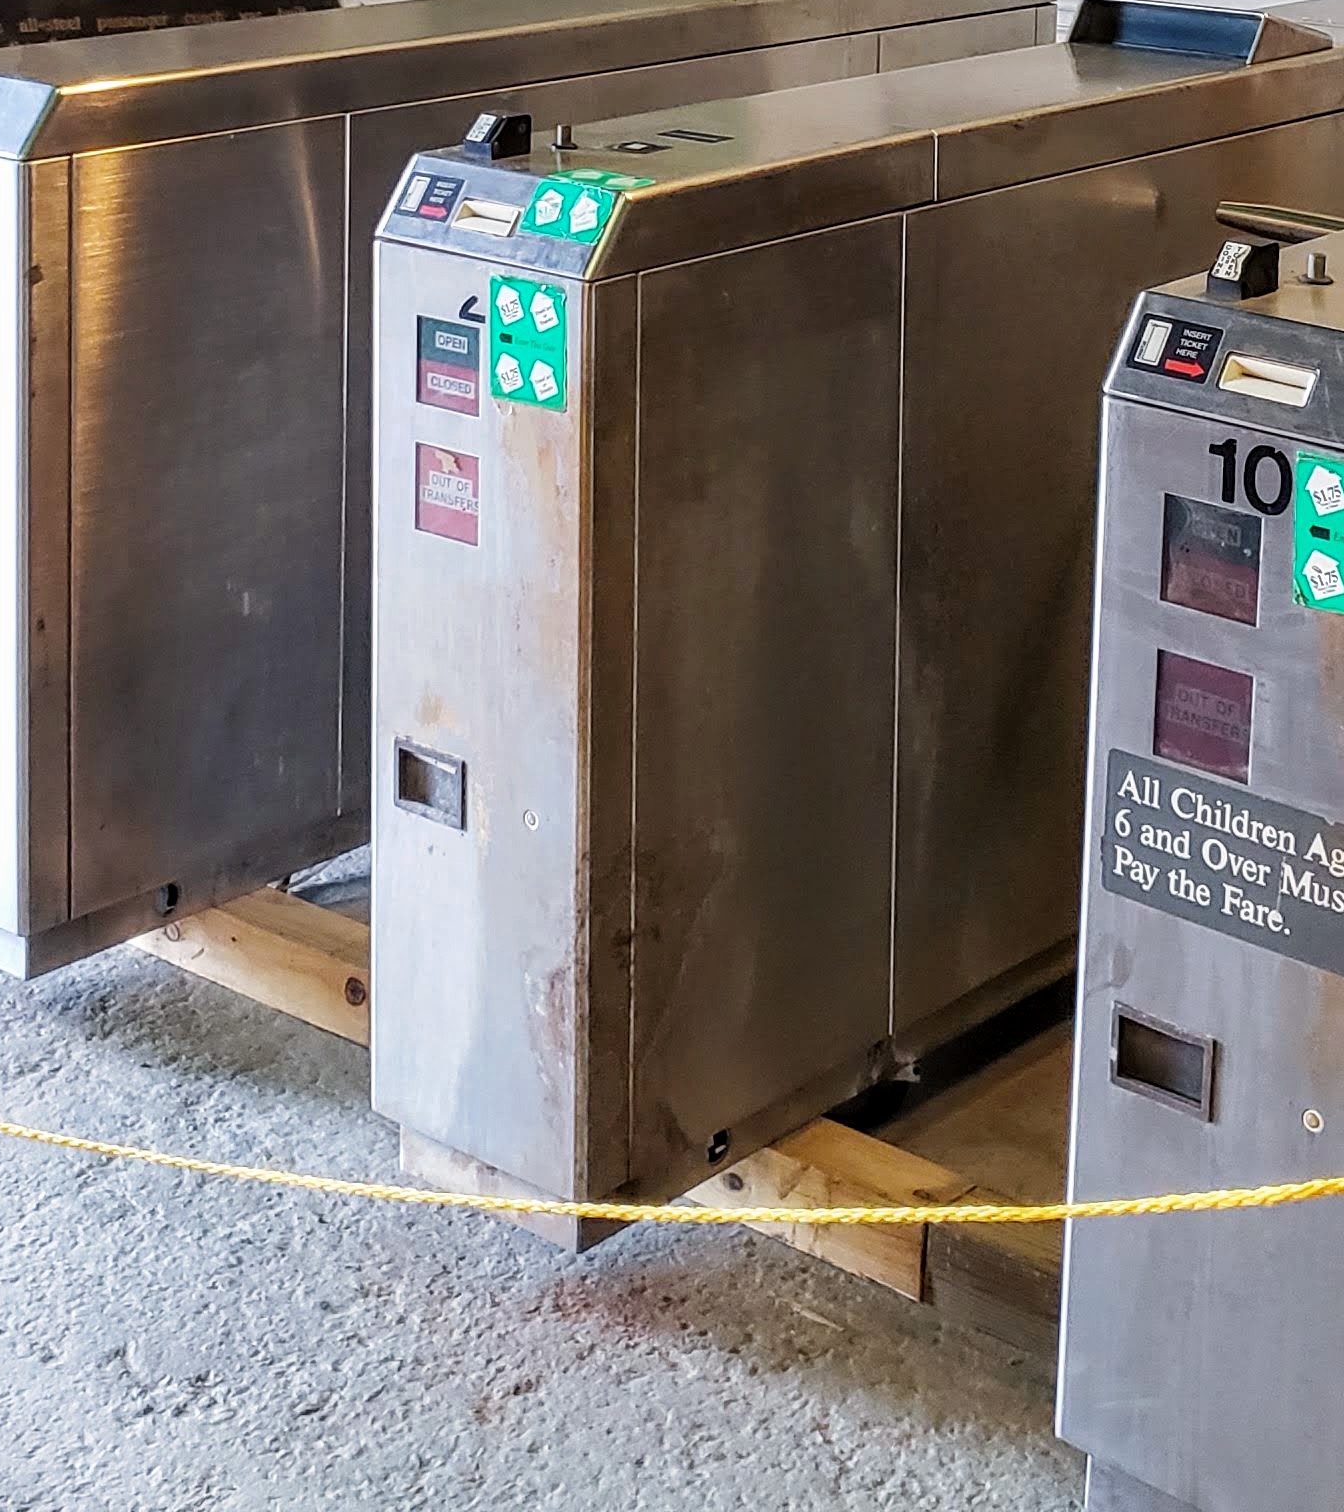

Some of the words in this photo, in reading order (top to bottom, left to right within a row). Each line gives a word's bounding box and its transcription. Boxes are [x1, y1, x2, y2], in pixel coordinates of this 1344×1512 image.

[437, 334, 467, 351] OPEN
[1180, 337, 1208, 352] TICKET
[1183, 329, 1213, 342] INSERT
[1175, 347, 1199, 360] HERE
[430, 375, 472, 394] CLOSED
[431, 473, 453, 489] OUT
[456, 479, 470, 493] OF
[1209, 438, 1294, 516] 10
[421, 488, 479, 512] TRANSFERS
[1313, 484, 1342, 503] $1.75
[1310, 569, 1339, 589] $1.75
[1178, 689, 1210, 707] OUT
[1117, 770, 1160, 809] All
[1171, 787, 1297, 856] Children
[1114, 808, 1133, 838] 6
[1140, 824, 1191, 860] and
[1202, 838, 1272, 886] Over
[1113, 844, 1160, 892] Pay
[1167, 868, 1211, 907] the
[1221, 883, 1291, 936] Fare.
